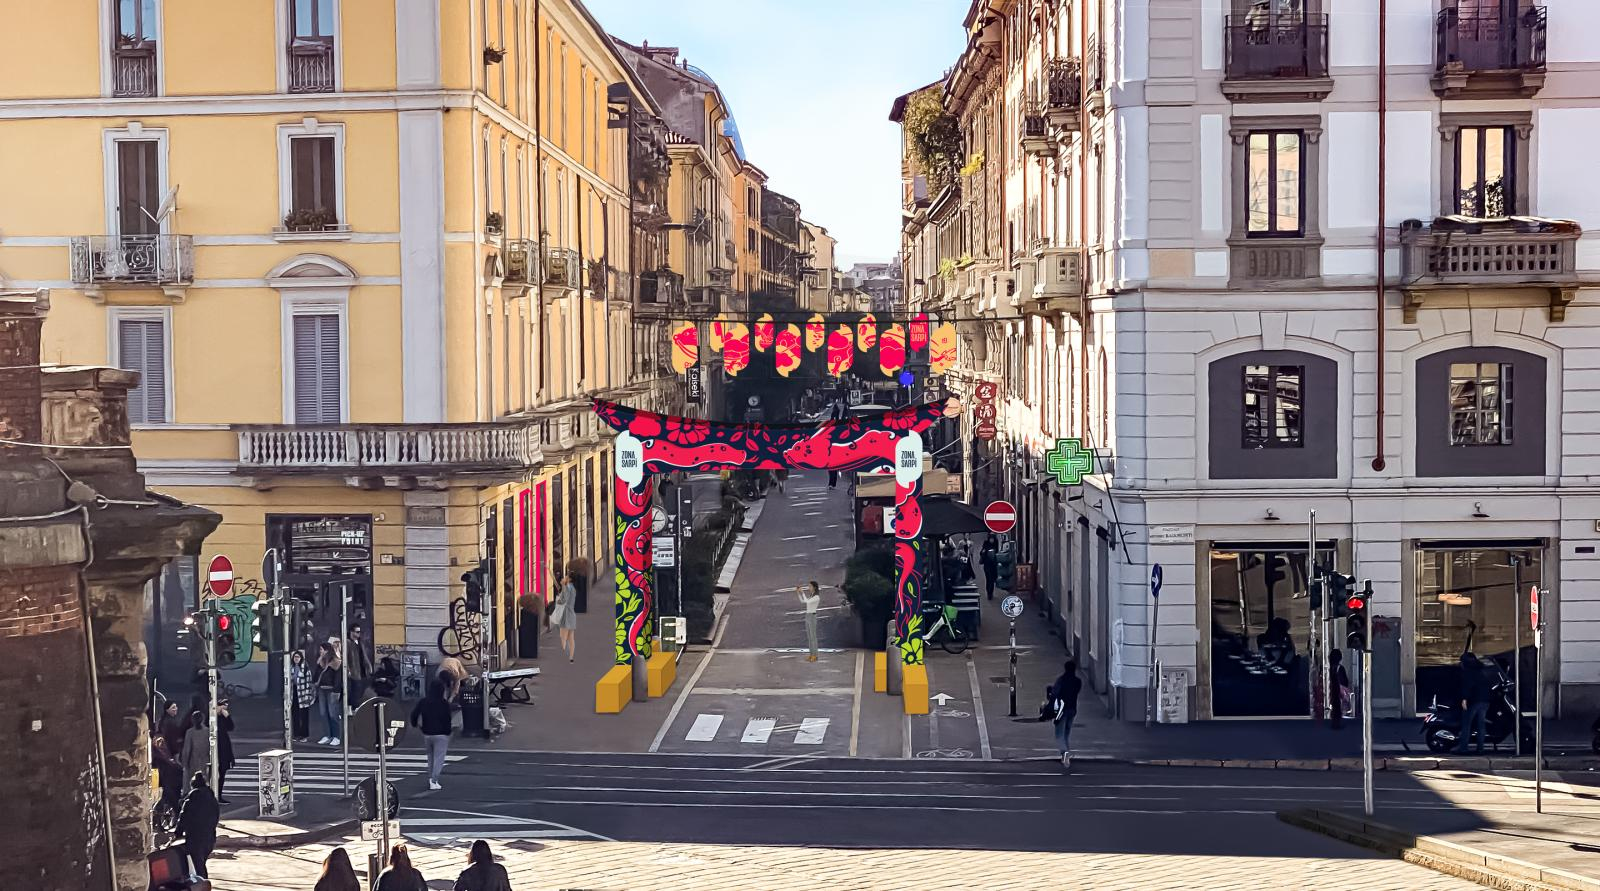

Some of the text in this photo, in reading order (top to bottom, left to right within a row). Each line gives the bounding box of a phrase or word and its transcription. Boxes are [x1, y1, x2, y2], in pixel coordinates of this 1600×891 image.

[911, 324, 924, 333] ZONA
[911, 332, 927, 342] SARPI
[621, 450, 636, 459] ZONA
[901, 450, 915, 459] ZONA
[621, 458, 638, 468] SARPI
[901, 458, 917, 468] SARPI
